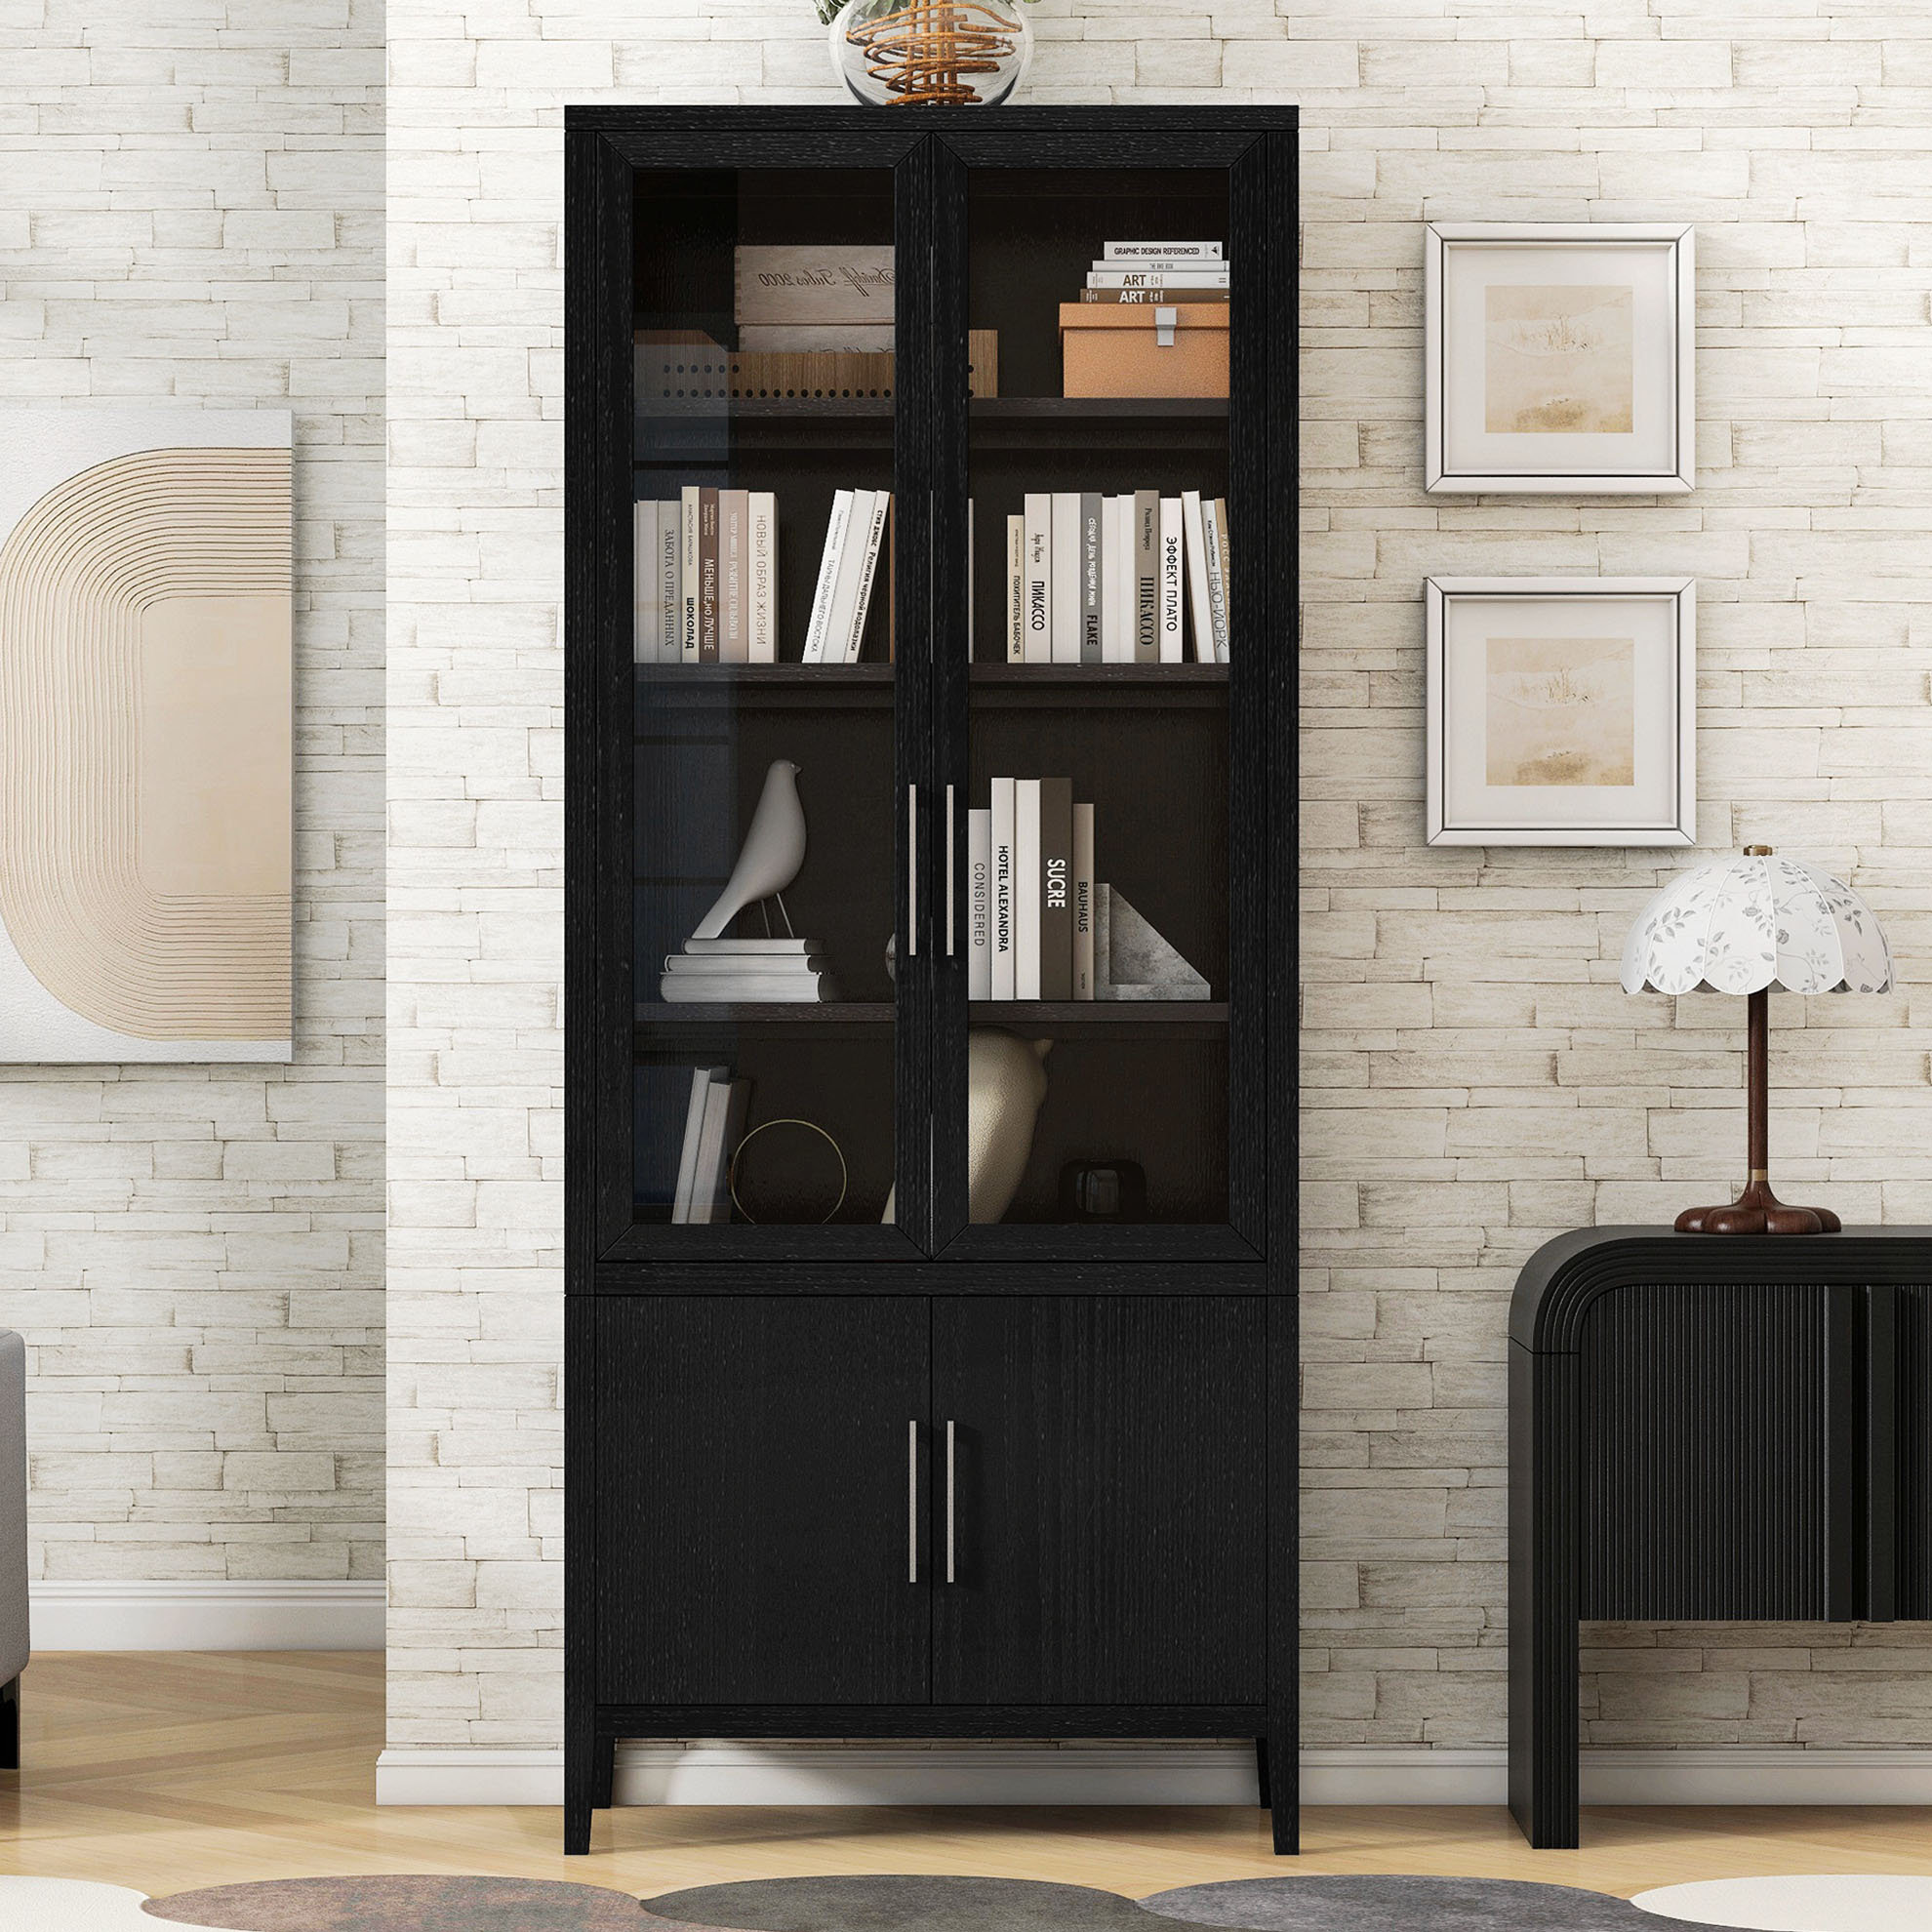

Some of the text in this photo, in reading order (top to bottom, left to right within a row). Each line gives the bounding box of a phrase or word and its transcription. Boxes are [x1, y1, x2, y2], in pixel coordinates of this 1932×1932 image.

[1114, 247, 1140, 256] GRAPHIC
[1141, 247, 1162, 256] DESIGN
[1163, 247, 1200, 256] REFERENCED
[1119, 291, 1146, 302] ART
[1123, 275, 1147, 287] ART
[664, 529, 675, 567] ЗАБОТА
[756, 515, 768, 645] НОВЫЙ ОБРАЗ ЖИЗНИ
[1166, 537, 1178, 632] ЭФФЕКТ ПЛАТО
[664, 582, 674, 646] ПРЕДАННЫХ
[685, 597, 695, 649] ШОКОЛАД
[1031, 581, 1045, 631] ПИКАССО
[1087, 615, 1098, 646] FLAKE
[1140, 577, 1154, 646] ПИКАССО
[704, 616, 714, 651] ЛУЧШЕ
[974, 863, 986, 946] CONSIDERED
[998, 846, 1009, 952] HOTEL ALEXANDRA
[1047, 859, 1066, 908] SUCRE
[1078, 881, 1088, 933] BAUHAUS
